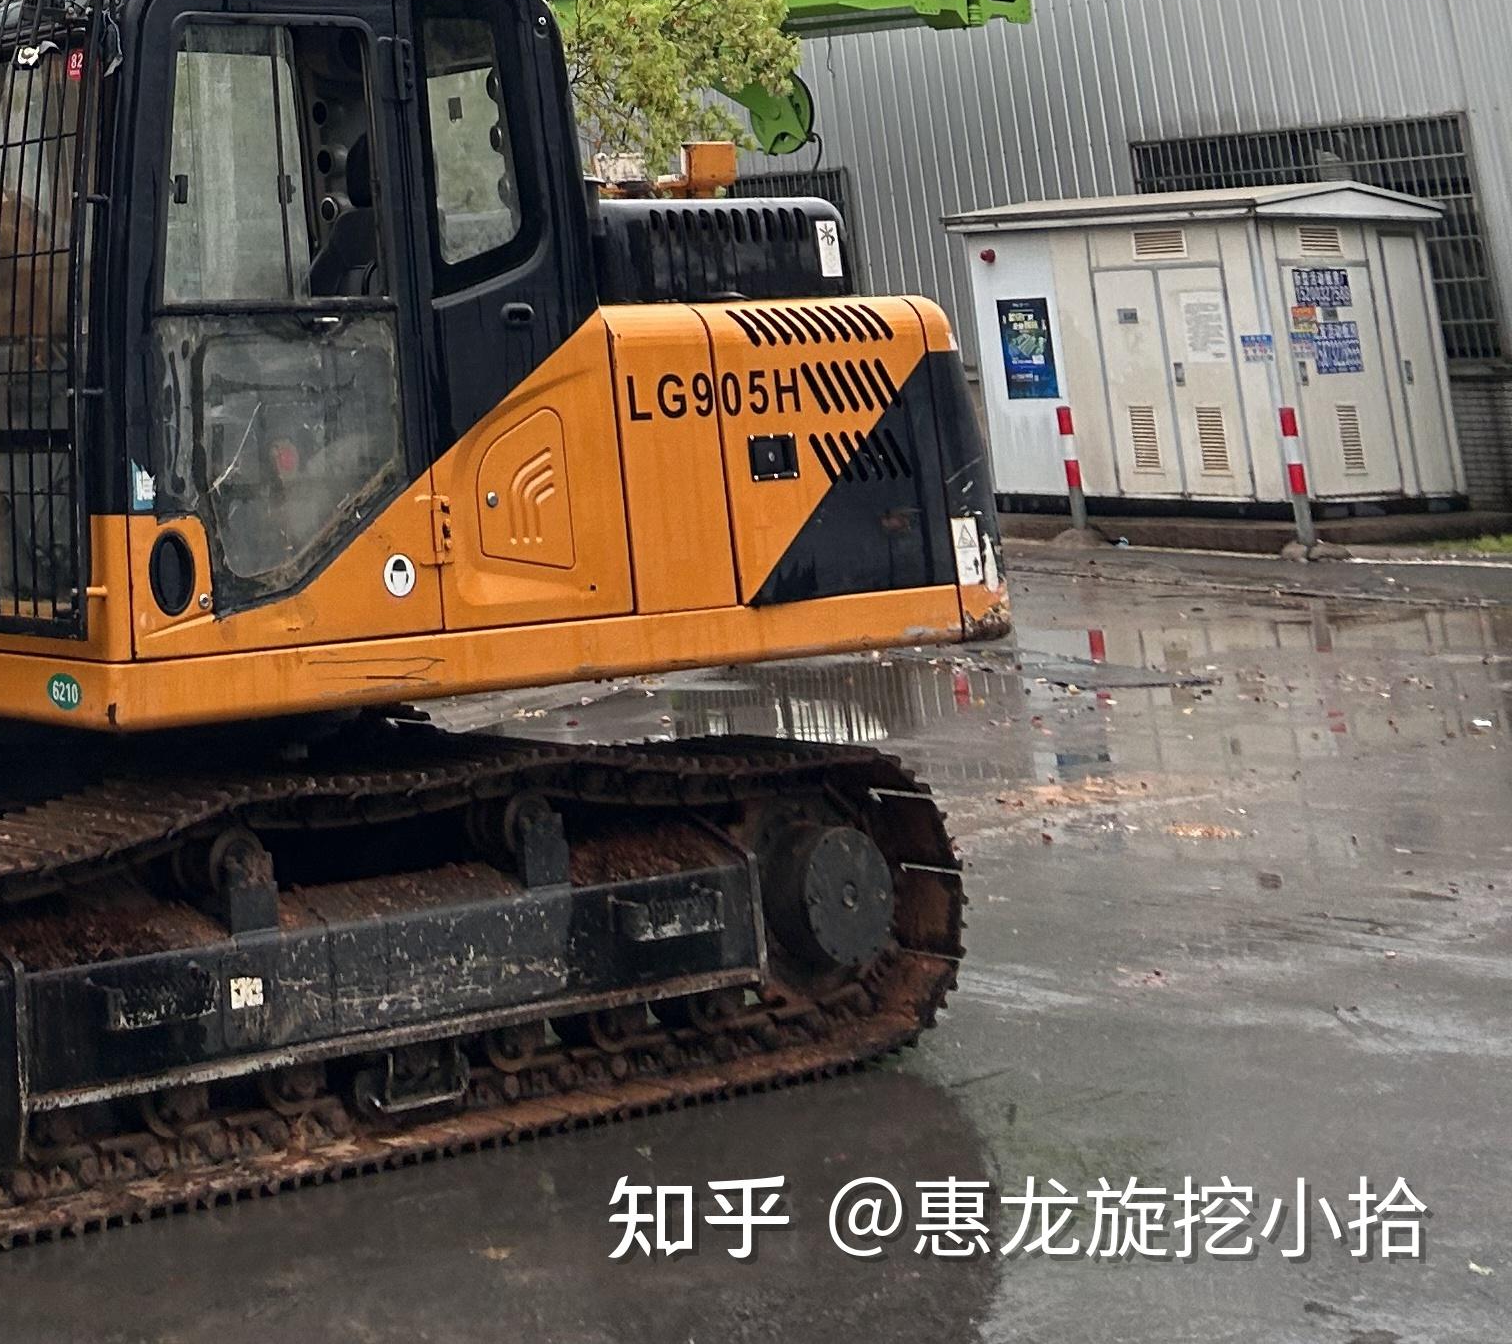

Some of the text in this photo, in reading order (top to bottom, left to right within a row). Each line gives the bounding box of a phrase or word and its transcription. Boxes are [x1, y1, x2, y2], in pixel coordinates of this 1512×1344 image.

[70, 52, 83, 69] 82
[626, 366, 802, 422] LG905H
[52, 680, 78, 704] 6210
